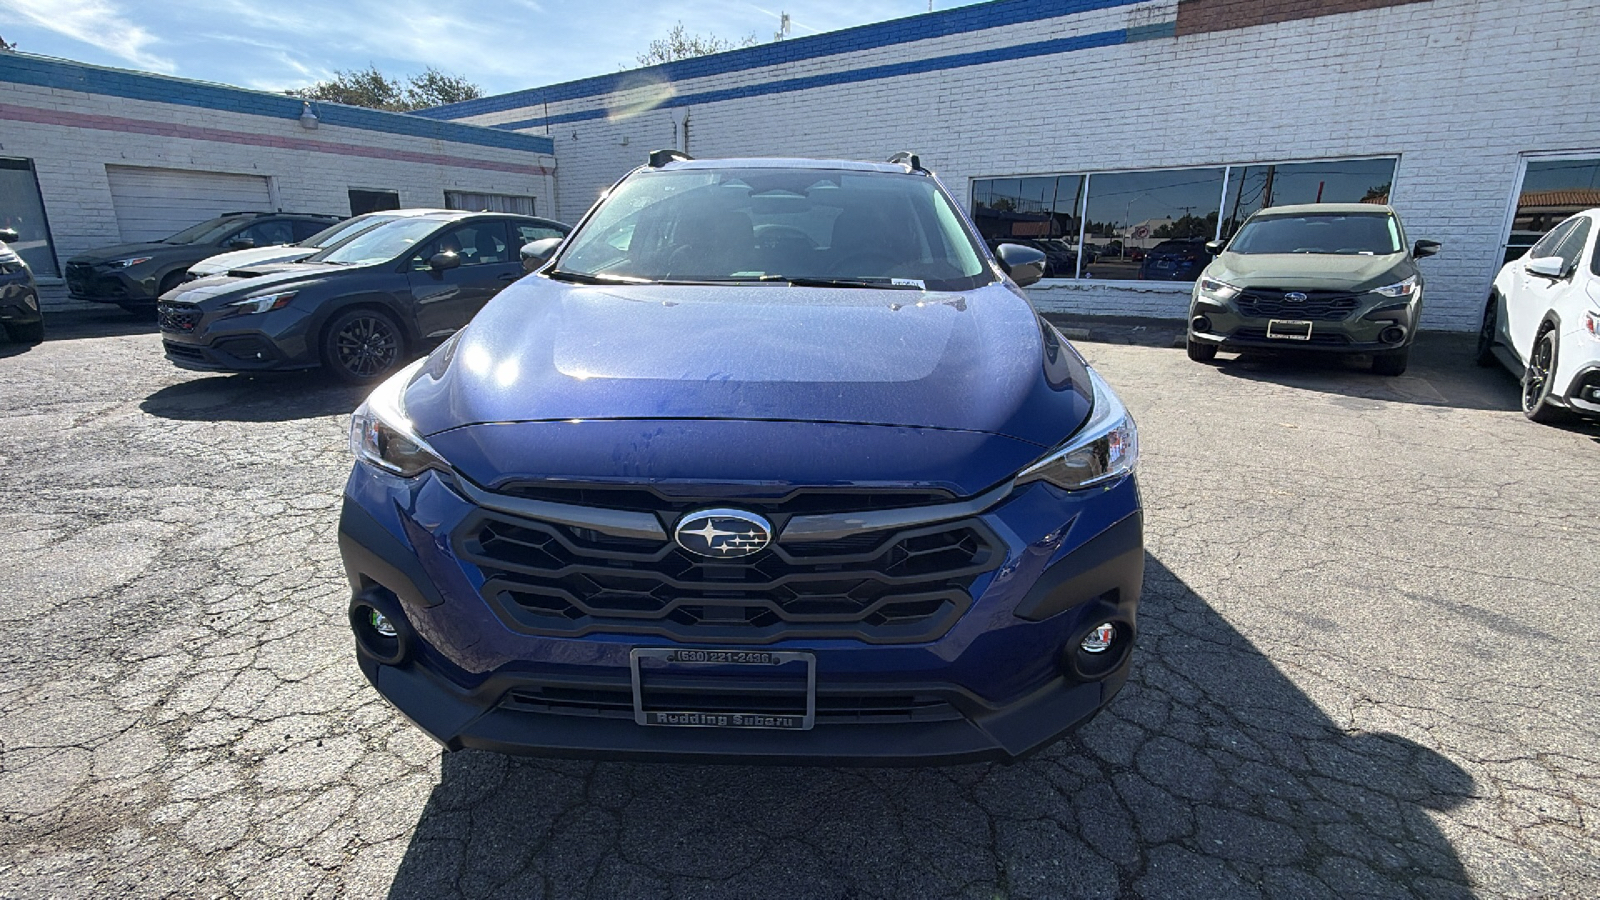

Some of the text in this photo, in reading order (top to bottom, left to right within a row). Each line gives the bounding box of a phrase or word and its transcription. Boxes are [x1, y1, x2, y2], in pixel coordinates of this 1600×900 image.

[677, 651, 769, 663] (530) 221-2436
[656, 713, 793, 727] Redding Subaru
